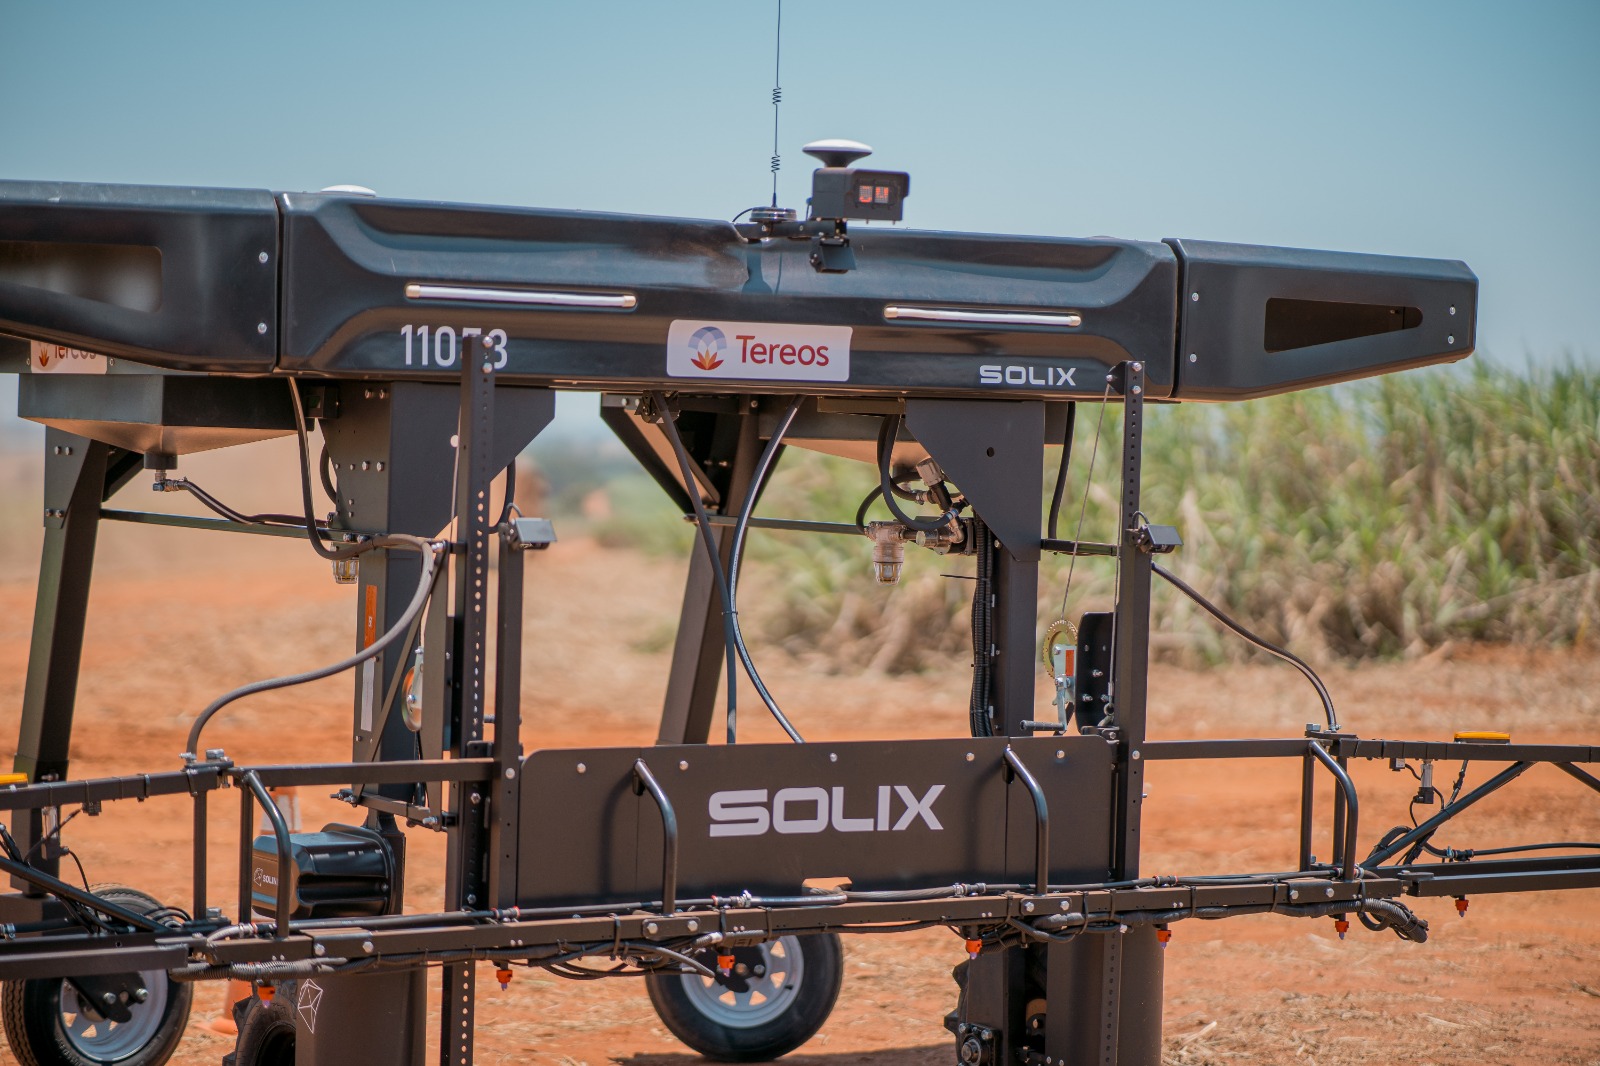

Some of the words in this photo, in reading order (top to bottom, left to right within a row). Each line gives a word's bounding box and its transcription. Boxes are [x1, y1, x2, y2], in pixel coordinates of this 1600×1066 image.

[401, 325, 508, 369] 1103
[736, 335, 829, 367] Tereos
[980, 365, 1077, 386] SOLIX
[709, 785, 946, 837] SOLIX
